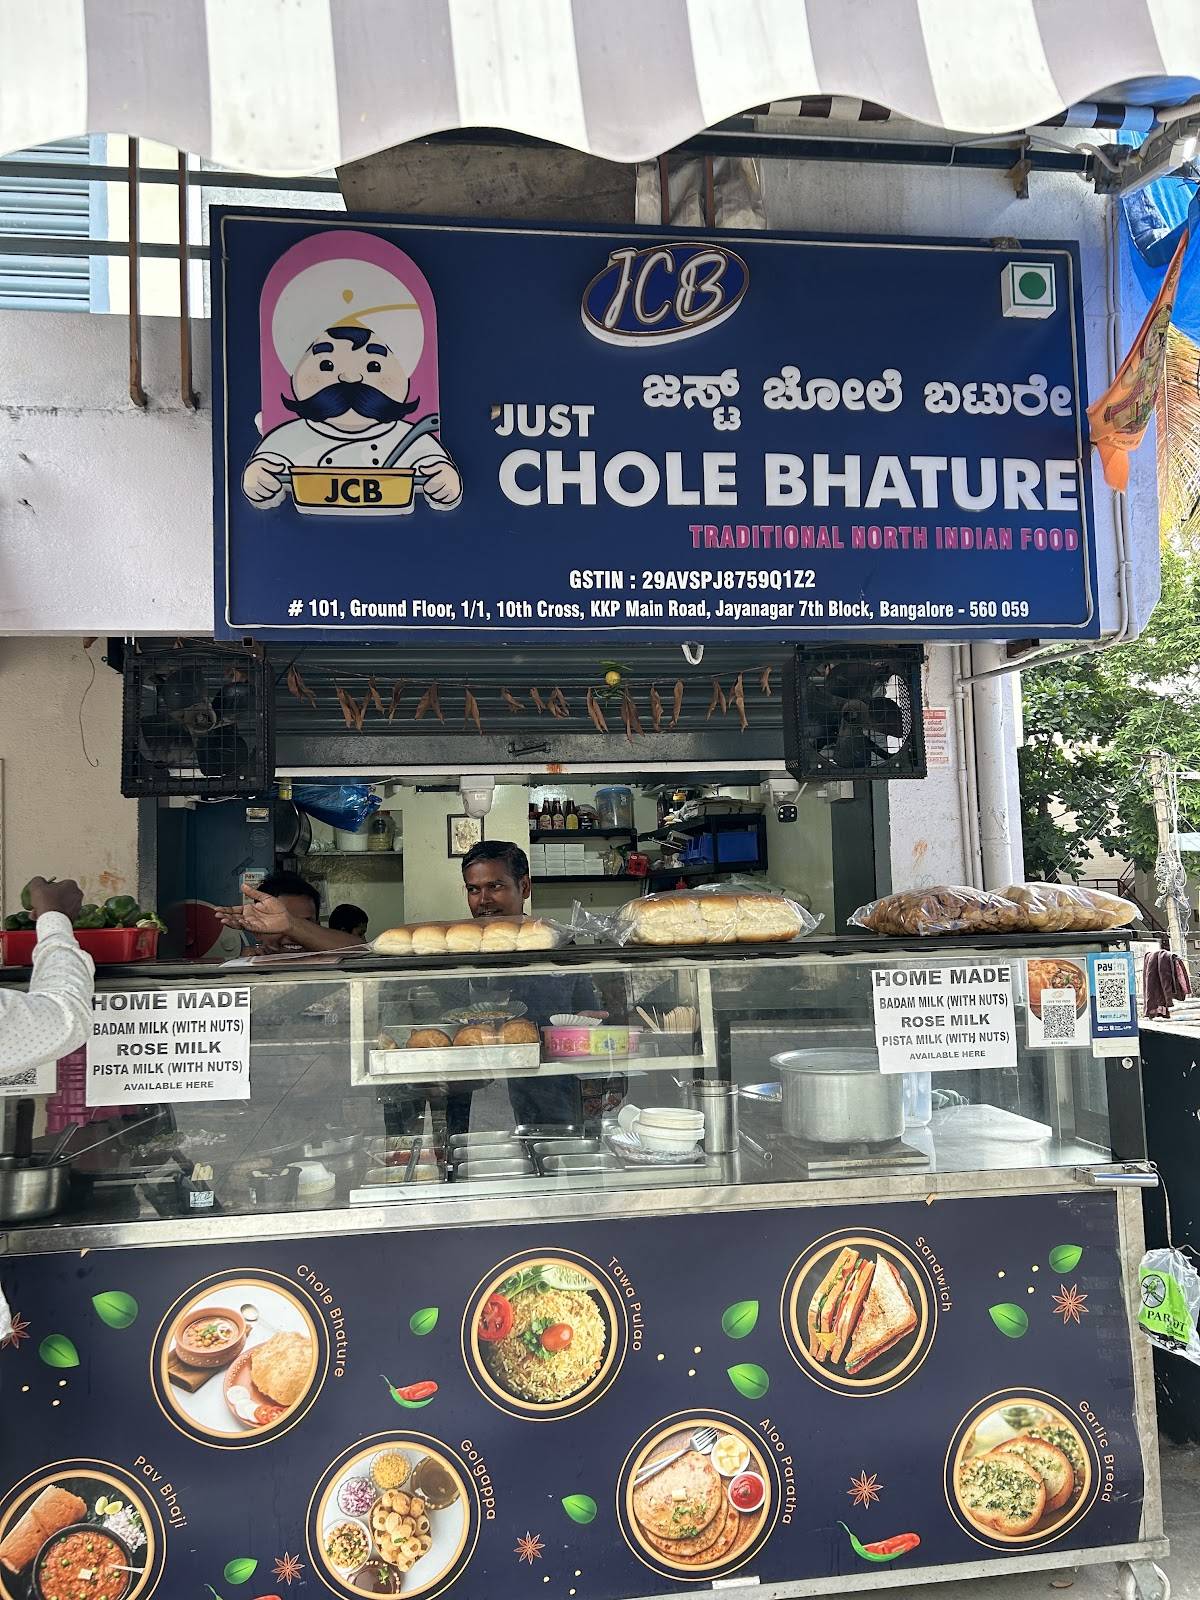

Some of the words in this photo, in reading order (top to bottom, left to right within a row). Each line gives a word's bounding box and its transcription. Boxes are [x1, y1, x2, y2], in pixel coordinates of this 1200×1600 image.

[604, 247, 728, 329] JCB
[642, 368, 741, 431] ಜಸ್ಟ್
[494, 403, 595, 438] JUST
[324, 479, 383, 504] JCB
[498, 448, 738, 507] CHOLE
[764, 452, 1079, 512] BHATURE
[688, 524, 845, 550] TRADITIONAL
[851, 525, 928, 550] NORTH
[935, 526, 1013, 550] INDIAN
[1020, 527, 1079, 551] FOOD
[569, 569, 624, 589] GSTIN
[630, 575, 636, 589] :
[642, 569, 816, 591] 29AVSPJ8759Q1Z2
[288, 600, 304, 617] #
[309, 599, 346, 620] 101,
[350, 599, 407, 617] Ground
[412, 600, 456, 620] Floor,
[461, 600, 491, 620] 1/1,
[496, 600, 533, 618] 10th
[537, 600, 585, 620] Cross,
[591, 600, 621, 617] KKP
[625, 600, 663, 617] Main
[669, 600, 711, 620] Road,
[715, 600, 794, 620] Jayanagar
[799, 600, 824, 617] 7th
[828, 600, 874, 620] Block,
[880, 600, 954, 620] Bangalore
[969, 600, 997, 618] 560
[1001, 600, 1029, 618] 059
[876, 970, 942, 987] HOME
[950, 967, 1011, 984] MADE
[92, 993, 168, 1011] HOME
[177, 991, 249, 1009] MADE
[879, 997, 915, 1009] BADAM
[918, 995, 944, 1008] MILK
[947, 994, 976, 1009] (WITH
[979, 993, 1008, 1007] NUTS)
[93, 1022, 135, 1036] BADAM
[139, 1021, 169, 1034] MILK
[172, 1020, 206, 1036] (WITH
[210, 1019, 244, 1035] NUTS)
[901, 1015, 945, 1028] ROSE
[950, 1014, 990, 1026] MILK
[116, 1043, 168, 1056] ROSE
[175, 1041, 222, 1055] MILK
[882, 1035, 913, 1046] PISTA
[916, 1034, 942, 1045] MILK
[945, 1033, 976, 1046] (WITH
[979, 1031, 1010, 1043] NUTS)
[909, 1051, 959, 1060] AVAILABLE
[962, 1050, 986, 1058] HERE
[93, 1064, 129, 1076] PISTA
[133, 1063, 164, 1075] MILK
[168, 1061, 203, 1076] (WITH
[207, 1060, 243, 1074] NUTS)
[124, 1082, 183, 1091] AVAILABLE
[186, 1080, 214, 1089] HERE
[915, 1236, 953, 1312] Sandwich
[608, 1256, 636, 1298] Tawa
[630, 1302, 645, 1351] Pulao
[297, 1264, 333, 1304] Chole
[329, 1307, 348, 1377] Bhature
[1079, 1400, 1108, 1448] Garlic
[1101, 1454, 1114, 1502] Bread
[461, 1439, 496, 1520] Golgappa
[759, 1418, 785, 1452] Aloo
[781, 1456, 797, 1524] Paratha
[134, 1455, 162, 1482] Pav
[160, 1483, 188, 1528] Bhaji
